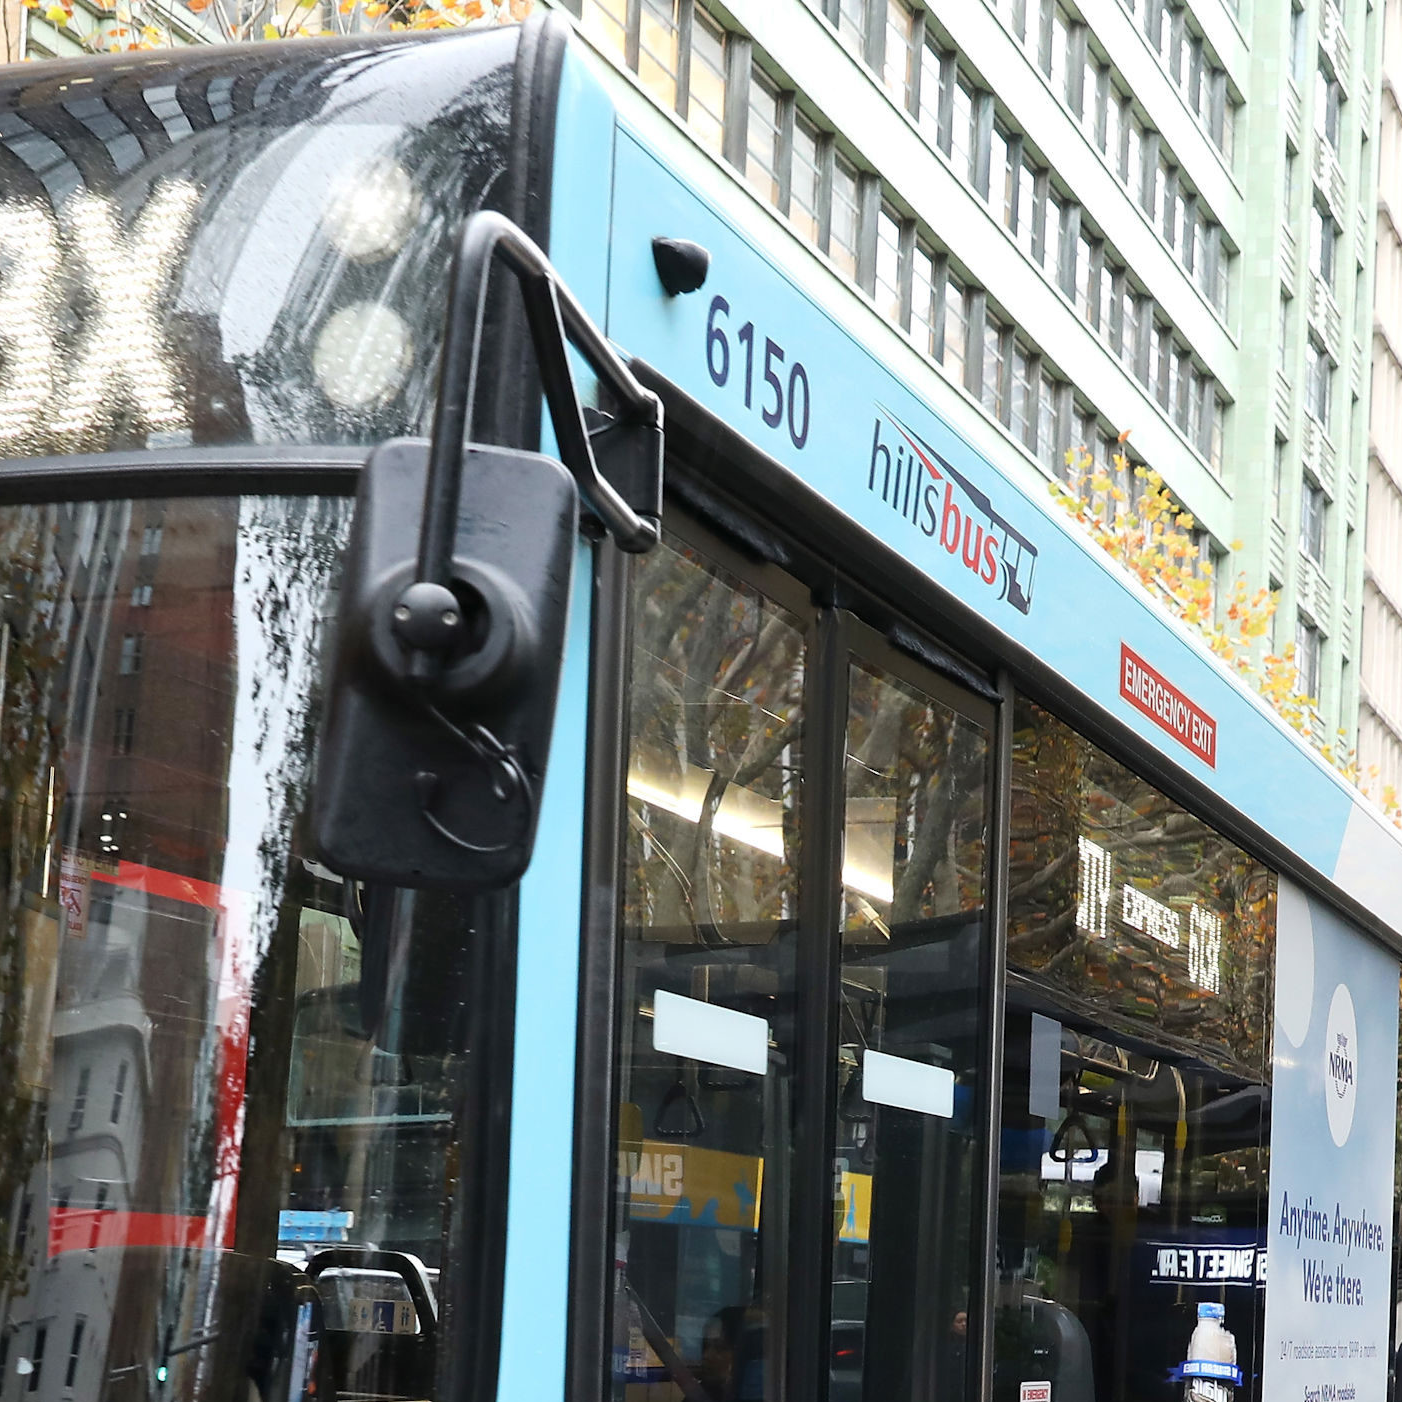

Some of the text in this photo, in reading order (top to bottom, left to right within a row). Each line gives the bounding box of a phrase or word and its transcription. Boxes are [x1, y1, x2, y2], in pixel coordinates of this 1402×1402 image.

[706, 294, 810, 450] 6150
[867, 417, 1000, 586] hillsbus
[1124, 656, 1214, 756] EMERGENCY EXIT
[1328, 1051, 1354, 1087] NRMA
[1279, 1190, 1384, 1257] Anytime. Anywhere.
[1303, 1258, 1333, 1305] We're
[1336, 1263, 1364, 1306] there.
[1321, 1384, 1337, 1402] NRMA
[1337, 1382, 1356, 1400] roadside
